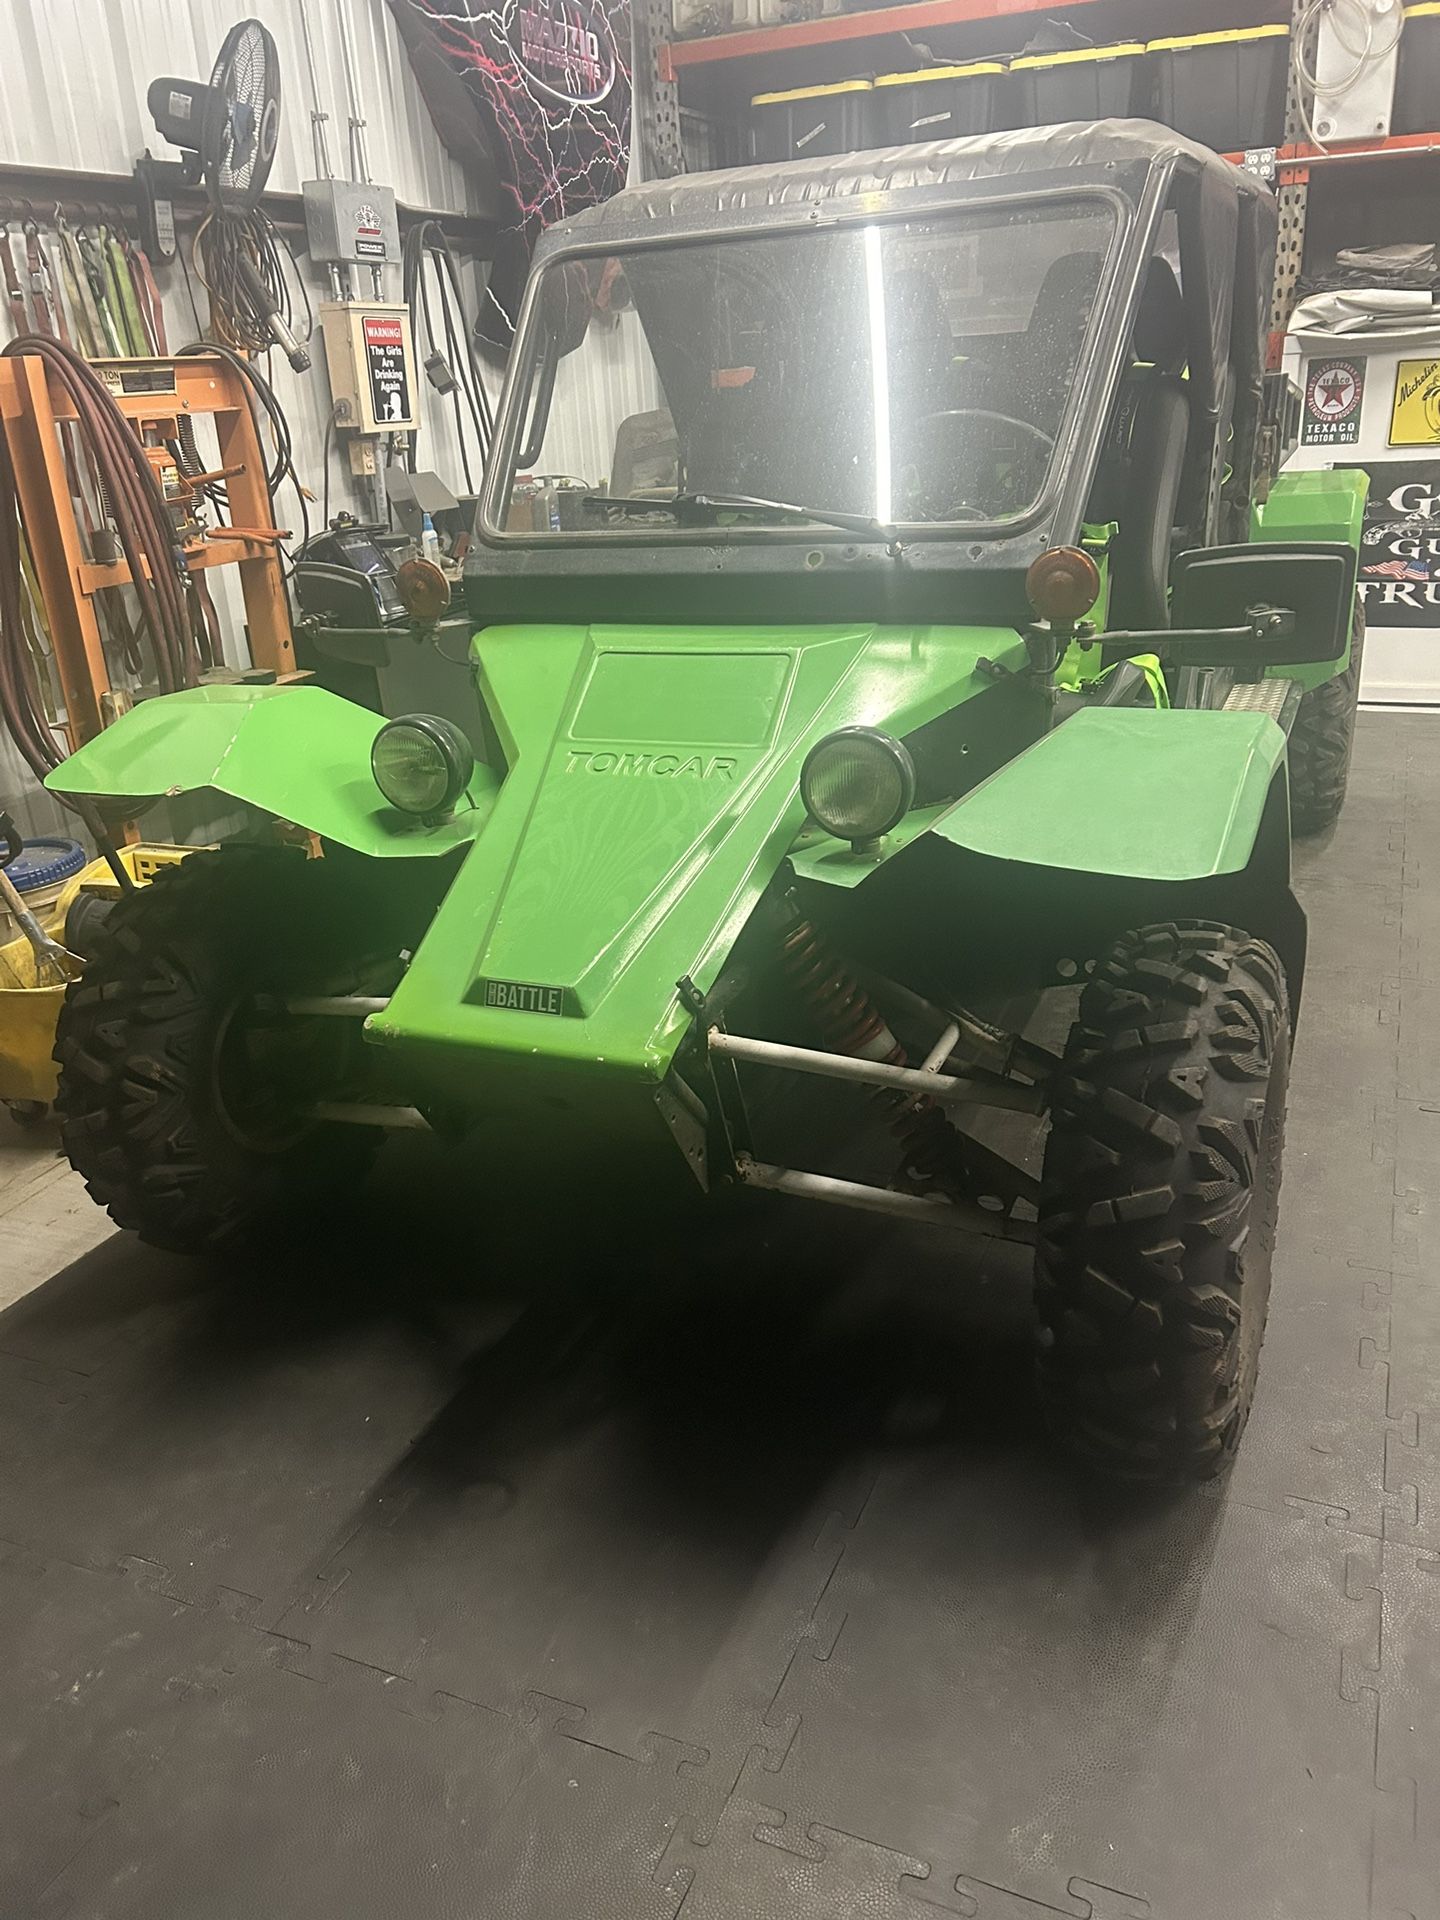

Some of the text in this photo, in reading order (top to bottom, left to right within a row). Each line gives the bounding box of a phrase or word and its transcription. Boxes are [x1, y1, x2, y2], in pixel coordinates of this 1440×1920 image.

[366, 326, 401, 338] WARNING!
[370, 345, 402, 356] The Girls
[381, 357, 394, 367] Are
[104, 371, 120, 380] TON
[374, 368, 403, 381] Drinking
[380, 380, 401, 393] Again
[1397, 362, 1438, 407] Michelin
[1307, 422, 1356, 433] TEXACO
[1305, 433, 1354, 443] MOTOR OIL
[1387, 483, 1440, 519] G
[565, 751, 738, 781] TOMCAR
[496, 984, 558, 1012] BATTLE
